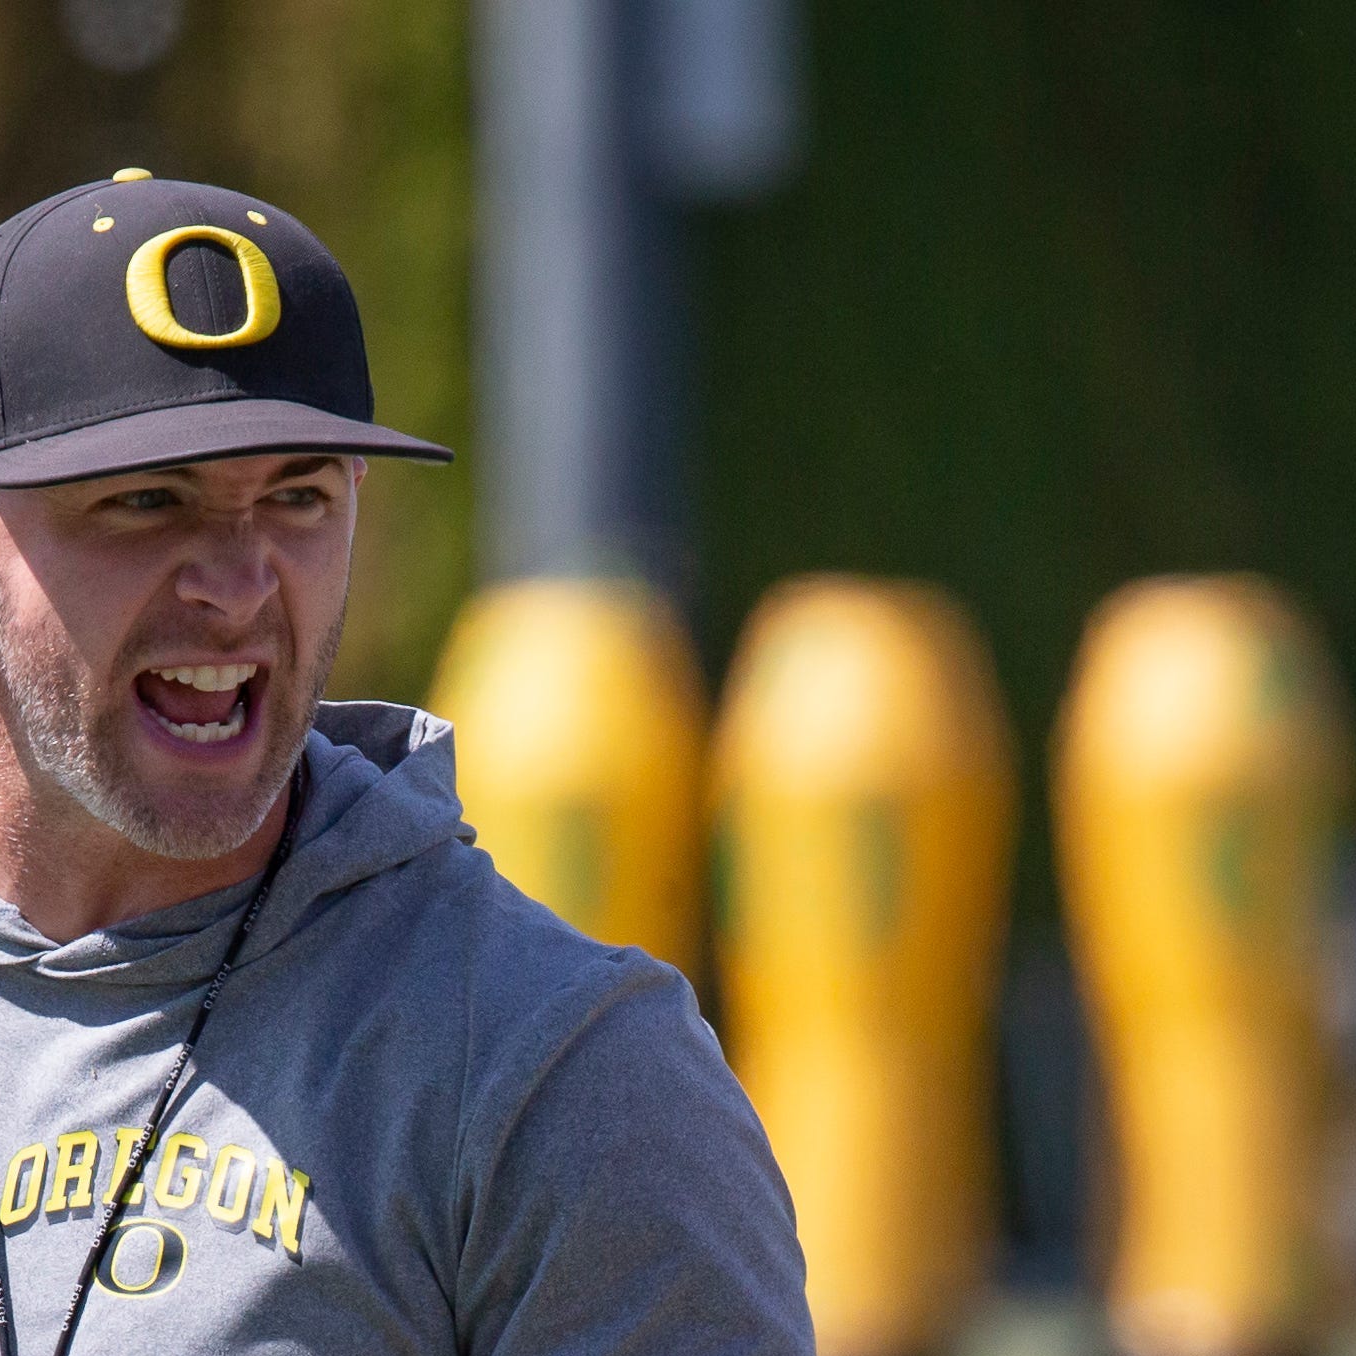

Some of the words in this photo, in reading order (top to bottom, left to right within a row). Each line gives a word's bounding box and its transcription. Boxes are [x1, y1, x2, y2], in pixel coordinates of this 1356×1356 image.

[126, 225, 282, 349] O
[204, 962, 232, 1010] FOX40
[166, 1043, 193, 1090] FOX40
[129, 1122, 155, 1169] FOX40
[0, 1127, 312, 1260] OREGON
[93, 1217, 189, 1299] O
